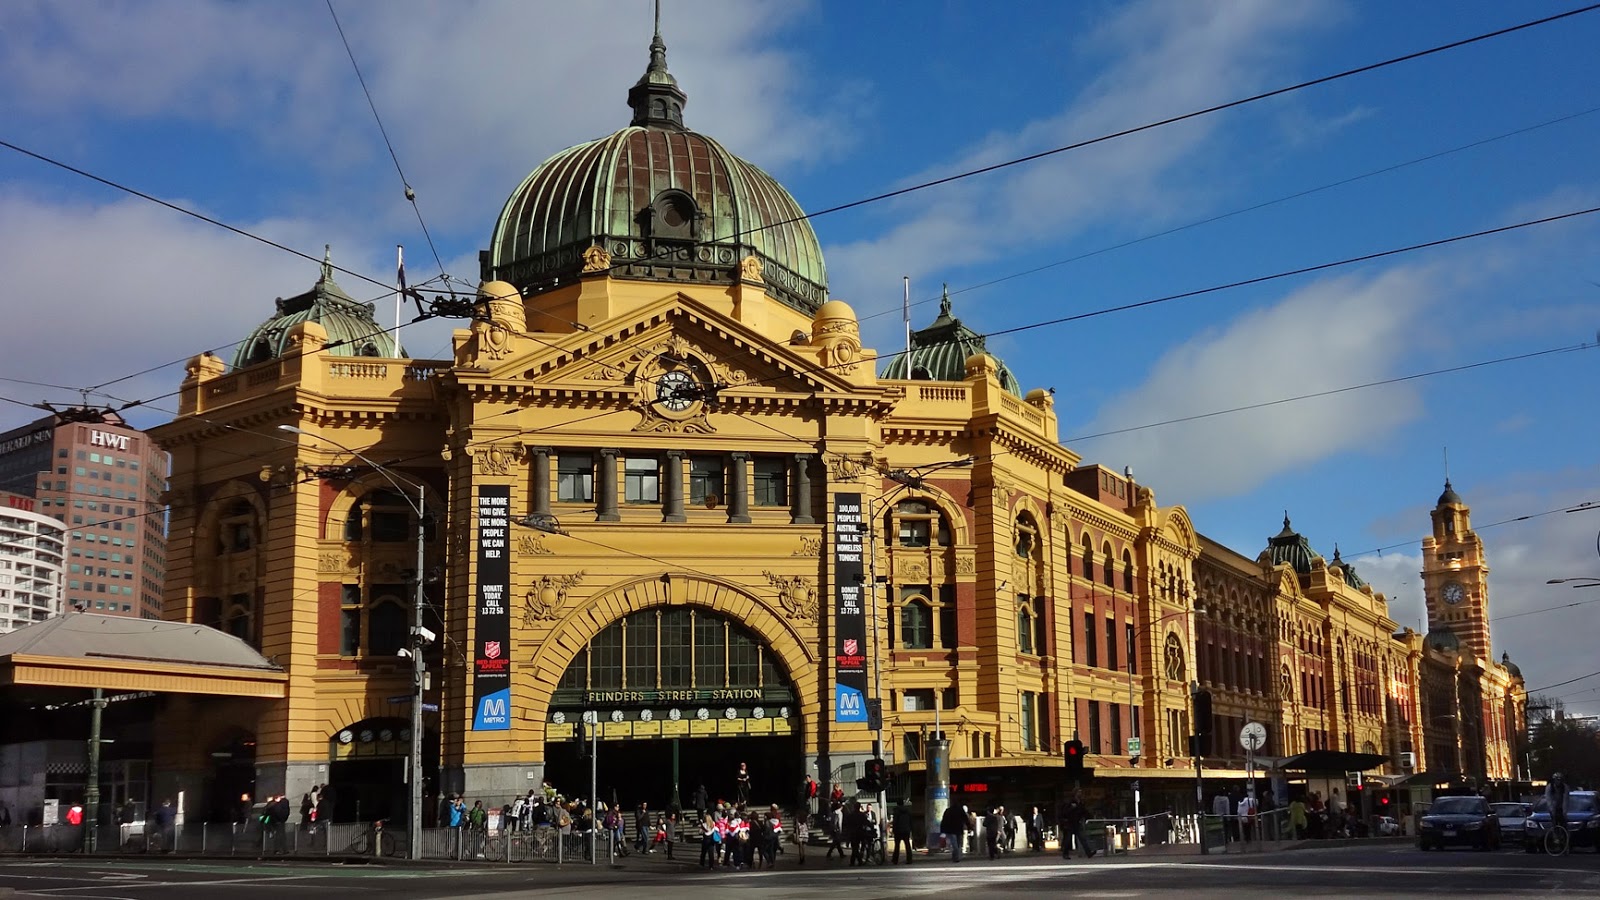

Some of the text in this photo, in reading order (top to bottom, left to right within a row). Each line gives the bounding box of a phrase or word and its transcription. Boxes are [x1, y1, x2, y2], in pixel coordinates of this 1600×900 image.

[34, 429, 52, 443] SUN
[91, 430, 130, 449] HWT
[480, 497, 508, 506] THE MORE
[480, 508, 506, 516] YOU GIVE.
[839, 505, 858, 513] 100,000
[480, 518, 507, 526] THE MORE
[482, 539, 504, 548] WE CAN
[486, 550, 501, 558] HELP.
[589, 689, 761, 701] FLINDERS STREET STATION
